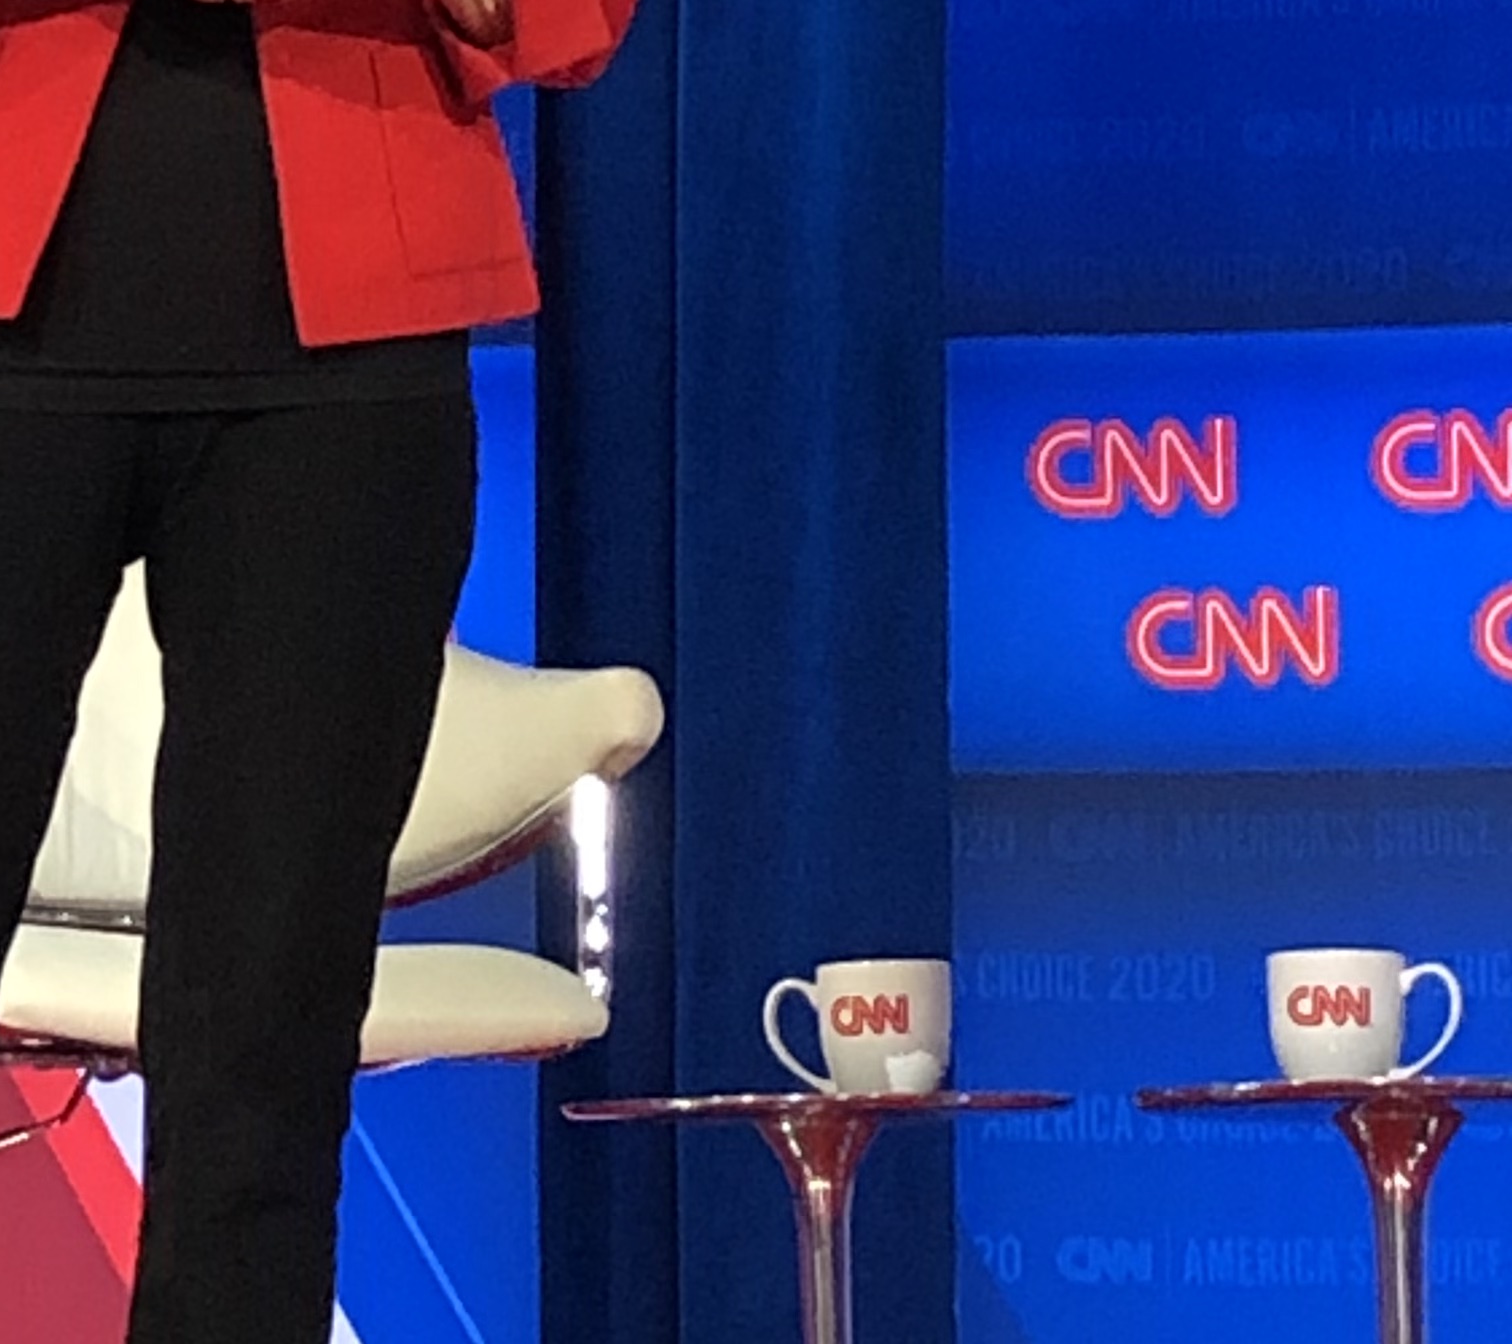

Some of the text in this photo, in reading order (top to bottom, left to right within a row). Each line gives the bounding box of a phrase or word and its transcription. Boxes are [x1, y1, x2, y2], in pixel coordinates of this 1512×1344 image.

[1025, 407, 1512, 520] CNN CN
[1126, 584, 1339, 691] CNN
[976, 952, 1094, 1001] CHOICE
[1107, 952, 1216, 1001] 2020
[830, 993, 911, 1037] CNN
[1287, 985, 1371, 1028] CNN
[1055, 1234, 1154, 1285] CNN
